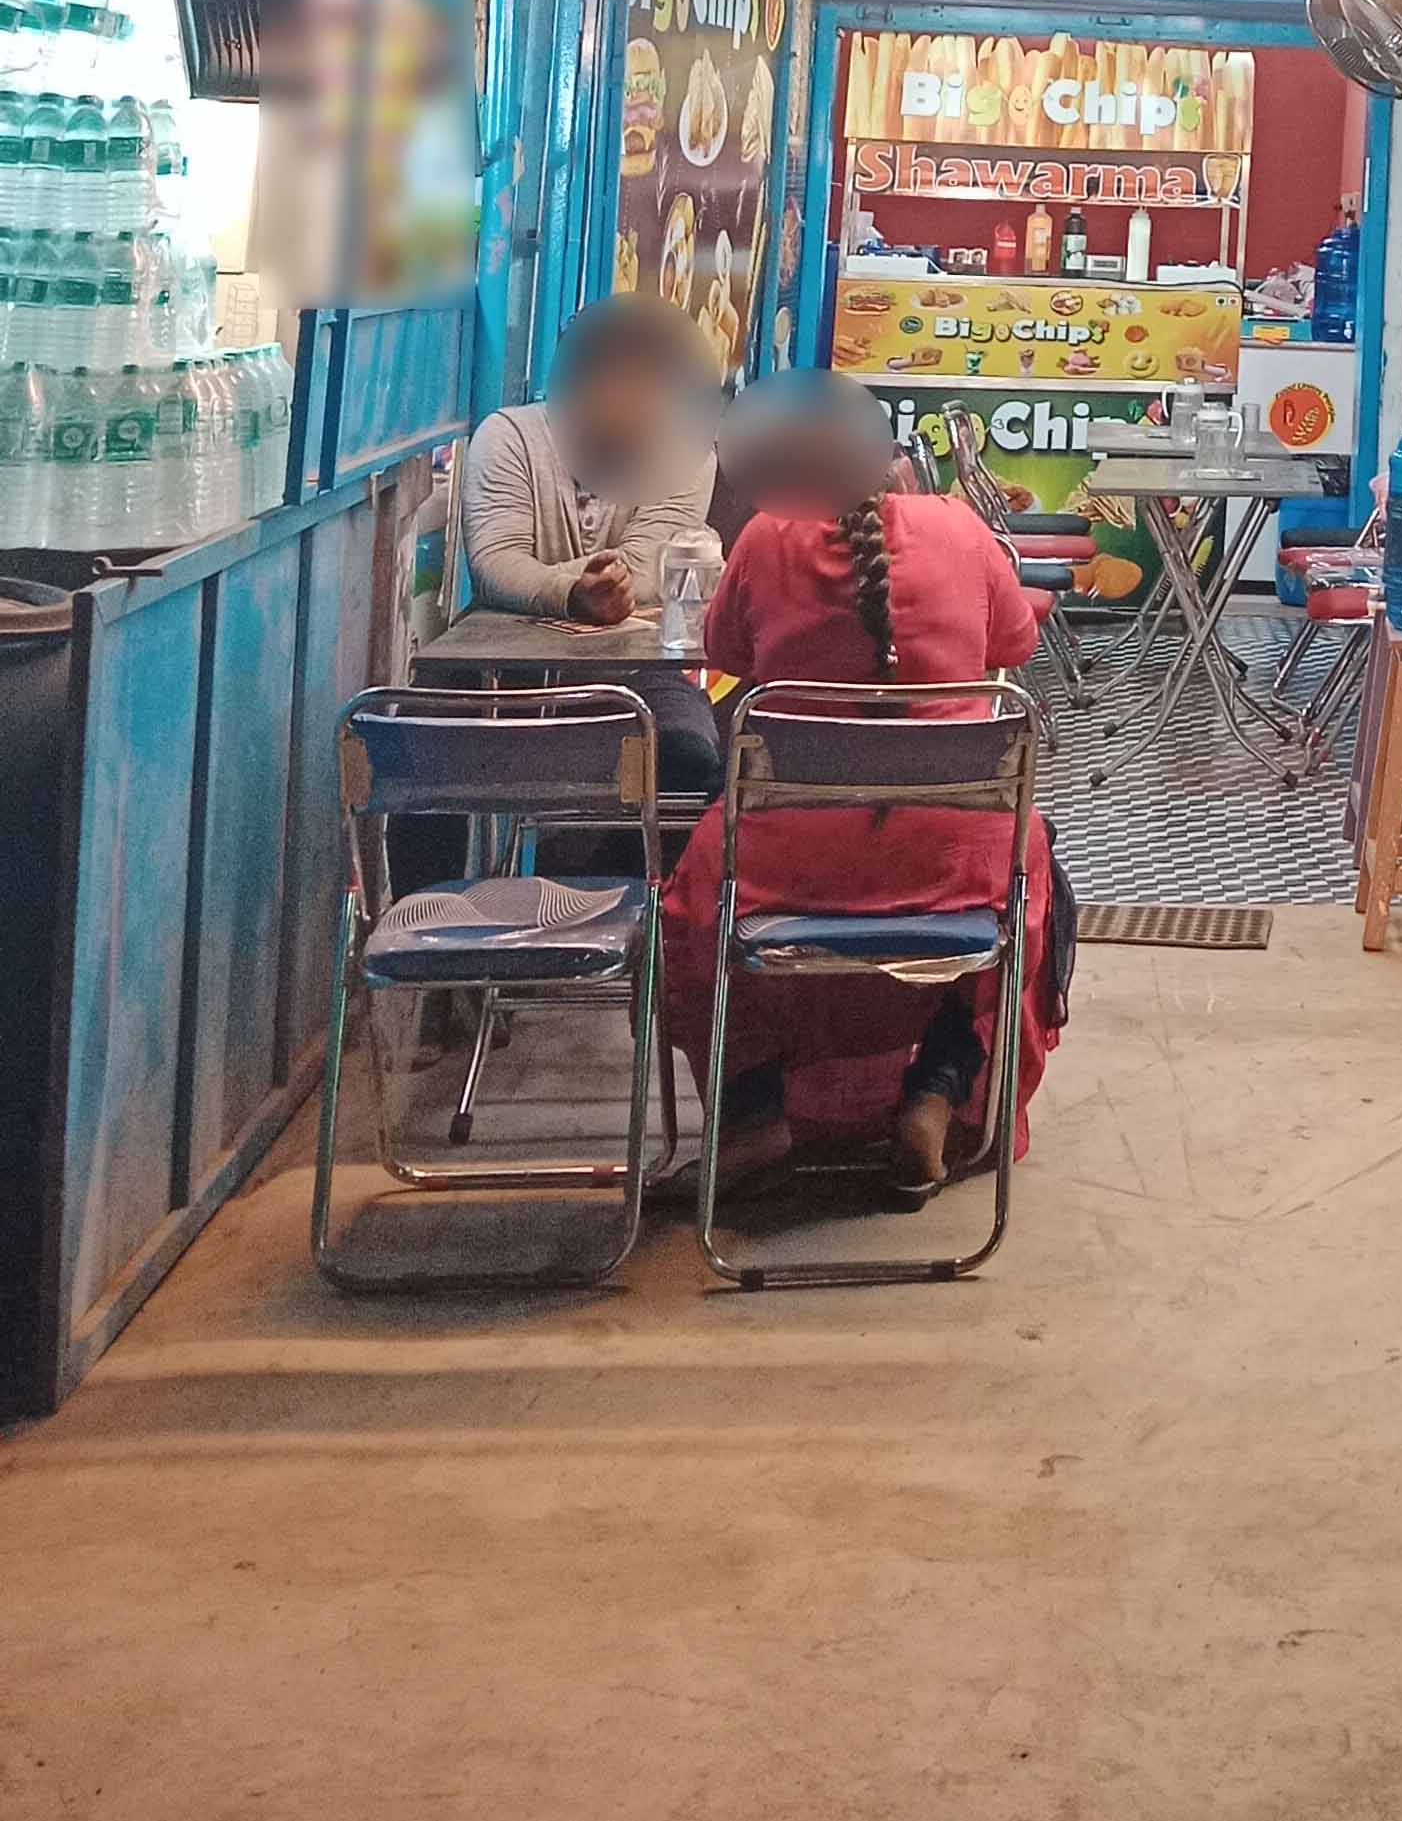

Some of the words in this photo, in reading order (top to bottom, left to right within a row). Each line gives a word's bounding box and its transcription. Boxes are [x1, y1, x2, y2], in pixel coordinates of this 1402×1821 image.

[900, 70, 1002, 127] Big
[855, 144, 1198, 202] Shawarma
[933, 315, 996, 343] Big
